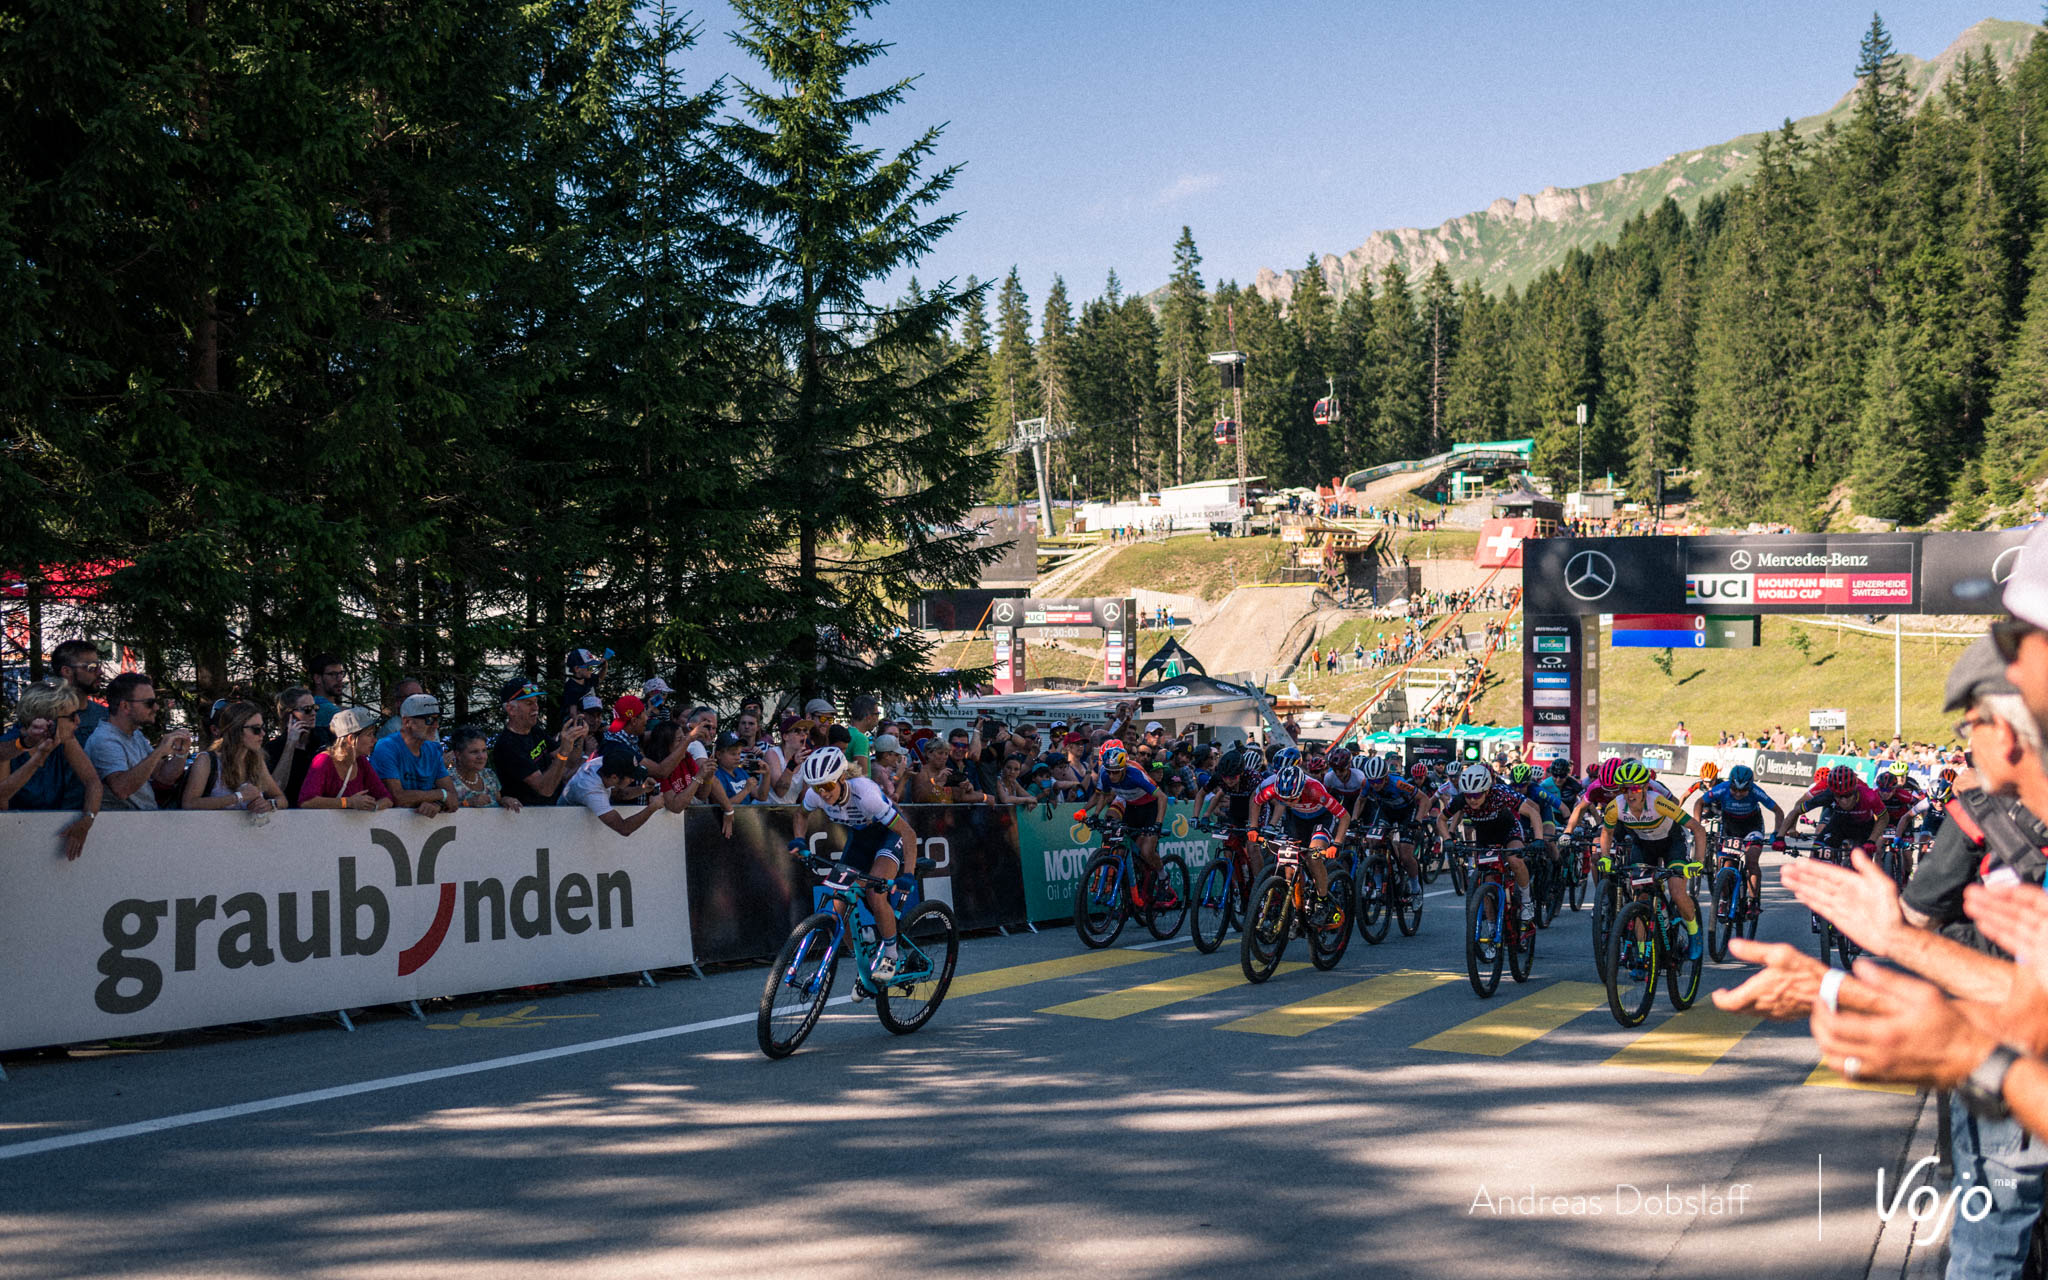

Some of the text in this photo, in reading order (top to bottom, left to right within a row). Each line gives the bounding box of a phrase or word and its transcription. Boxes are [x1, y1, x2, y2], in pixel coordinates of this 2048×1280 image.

[1757, 552, 1869, 568] Mercedes-Benz
[1698, 579, 1748, 599] UCI
[1757, 578, 1844, 589] MOUNTAIN BIKE
[1852, 579, 1907, 589] LENZERHEIDE
[1757, 588, 1822, 599] WORLD CUP
[1852, 588, 1908, 597] SWITZERLAND
[1029, 613, 1045, 621] UCI
[1694, 615, 1705, 630] 0
[1039, 628, 1080, 638] 17:30:03
[1694, 633, 1705, 647] 0
[1538, 711, 1566, 721] X-Class
[1817, 716, 1838, 725] 25m
[1642, 748, 1673, 758] GoPro
[1726, 838, 1740, 849] 18
[1817, 847, 1831, 860] 16
[838, 871, 848, 884] 1
[1047, 883, 1061, 901] Oil
[1062, 883, 1073, 899] of
